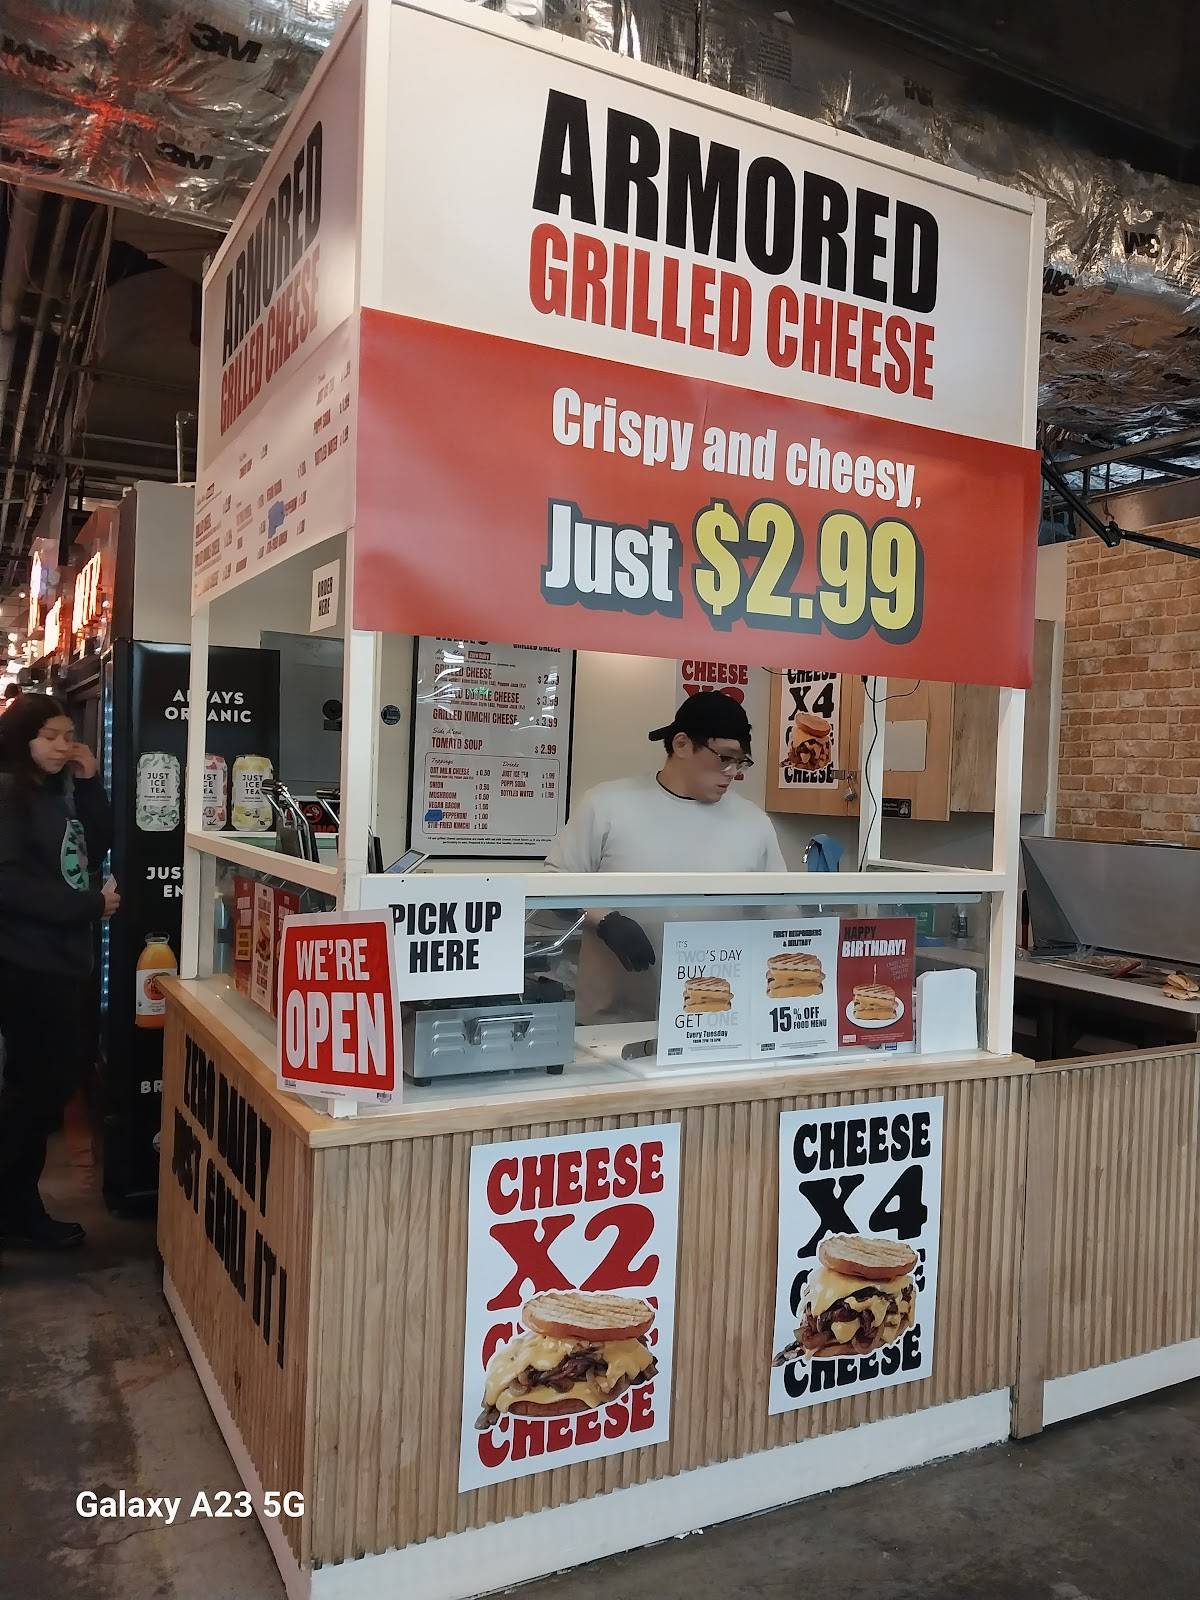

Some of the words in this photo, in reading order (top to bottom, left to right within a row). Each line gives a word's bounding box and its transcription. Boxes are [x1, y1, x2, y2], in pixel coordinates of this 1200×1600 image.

[190, 22, 262, 64] 3M
[532, 88, 939, 313] ARMORED
[222, 120, 323, 367] ARMORED
[529, 223, 752, 358] GRILLED
[766, 284, 935, 400] CHEESE
[220, 322, 264, 437] GRILLED
[265, 242, 321, 384] CHEESE
[551, 387, 694, 471] Crispy
[702, 427, 777, 481] and
[785, 438, 922, 509] cheesy,
[543, 500, 678, 610] Just
[692, 499, 921, 635] $2.99
[317, 576, 333, 598] ORDER
[318, 597, 331, 617] HERE
[466, 667, 492, 680] CHEESE
[681, 659, 749, 685] CHEESE
[787, 668, 837, 685] CHEESE
[172, 688, 244, 705] AAYS
[494, 691, 520, 704] CHEESE
[788, 682, 835, 721] X4
[164, 706, 252, 723] ORANIC
[433, 708, 462, 721] GRILLED
[464, 710, 490, 723] KIMCHI
[492, 712, 518, 725] CHEESE
[432, 736, 462, 749] TOMATO
[464, 739, 483, 751] SOUP
[540, 743, 557, 755] 2.99
[146, 772, 169, 780] JUST
[452, 768, 470, 776] CHEESE
[784, 763, 834, 784] CHEESE
[428, 791, 457, 799] MUSHROOM
[388, 902, 458, 936] PICK
[464, 900, 502, 933] UP
[773, 930, 788, 938] FIRST
[844, 926, 876, 941] HAPPY
[409, 938, 480, 974] HERE
[719, 949, 743, 962] DAY
[841, 939, 907, 958] BIRTHDAY!
[296, 938, 370, 982] WE'RE
[677, 965, 706, 980] BUY
[710, 963, 741, 979] ONE
[674, 1013, 703, 1029] GET
[706, 1012, 739, 1026] ONE
[803, 1006, 820, 1020] OFF
[285, 989, 387, 1077] OPEN
[686, 1031, 703, 1040] Every
[703, 1029, 728, 1038] Tuesday
[793, 1020, 809, 1030] FOOD
[810, 1018, 828, 1028] MENU
[792, 1111, 931, 1174] CHEESE
[486, 1140, 665, 1216] CHEESE
[796, 1163, 929, 1260] X4
[486, 1202, 661, 1312] X2
[783, 1323, 923, 1399] CHEESE
[477, 1382, 656, 1469] CHEESE
